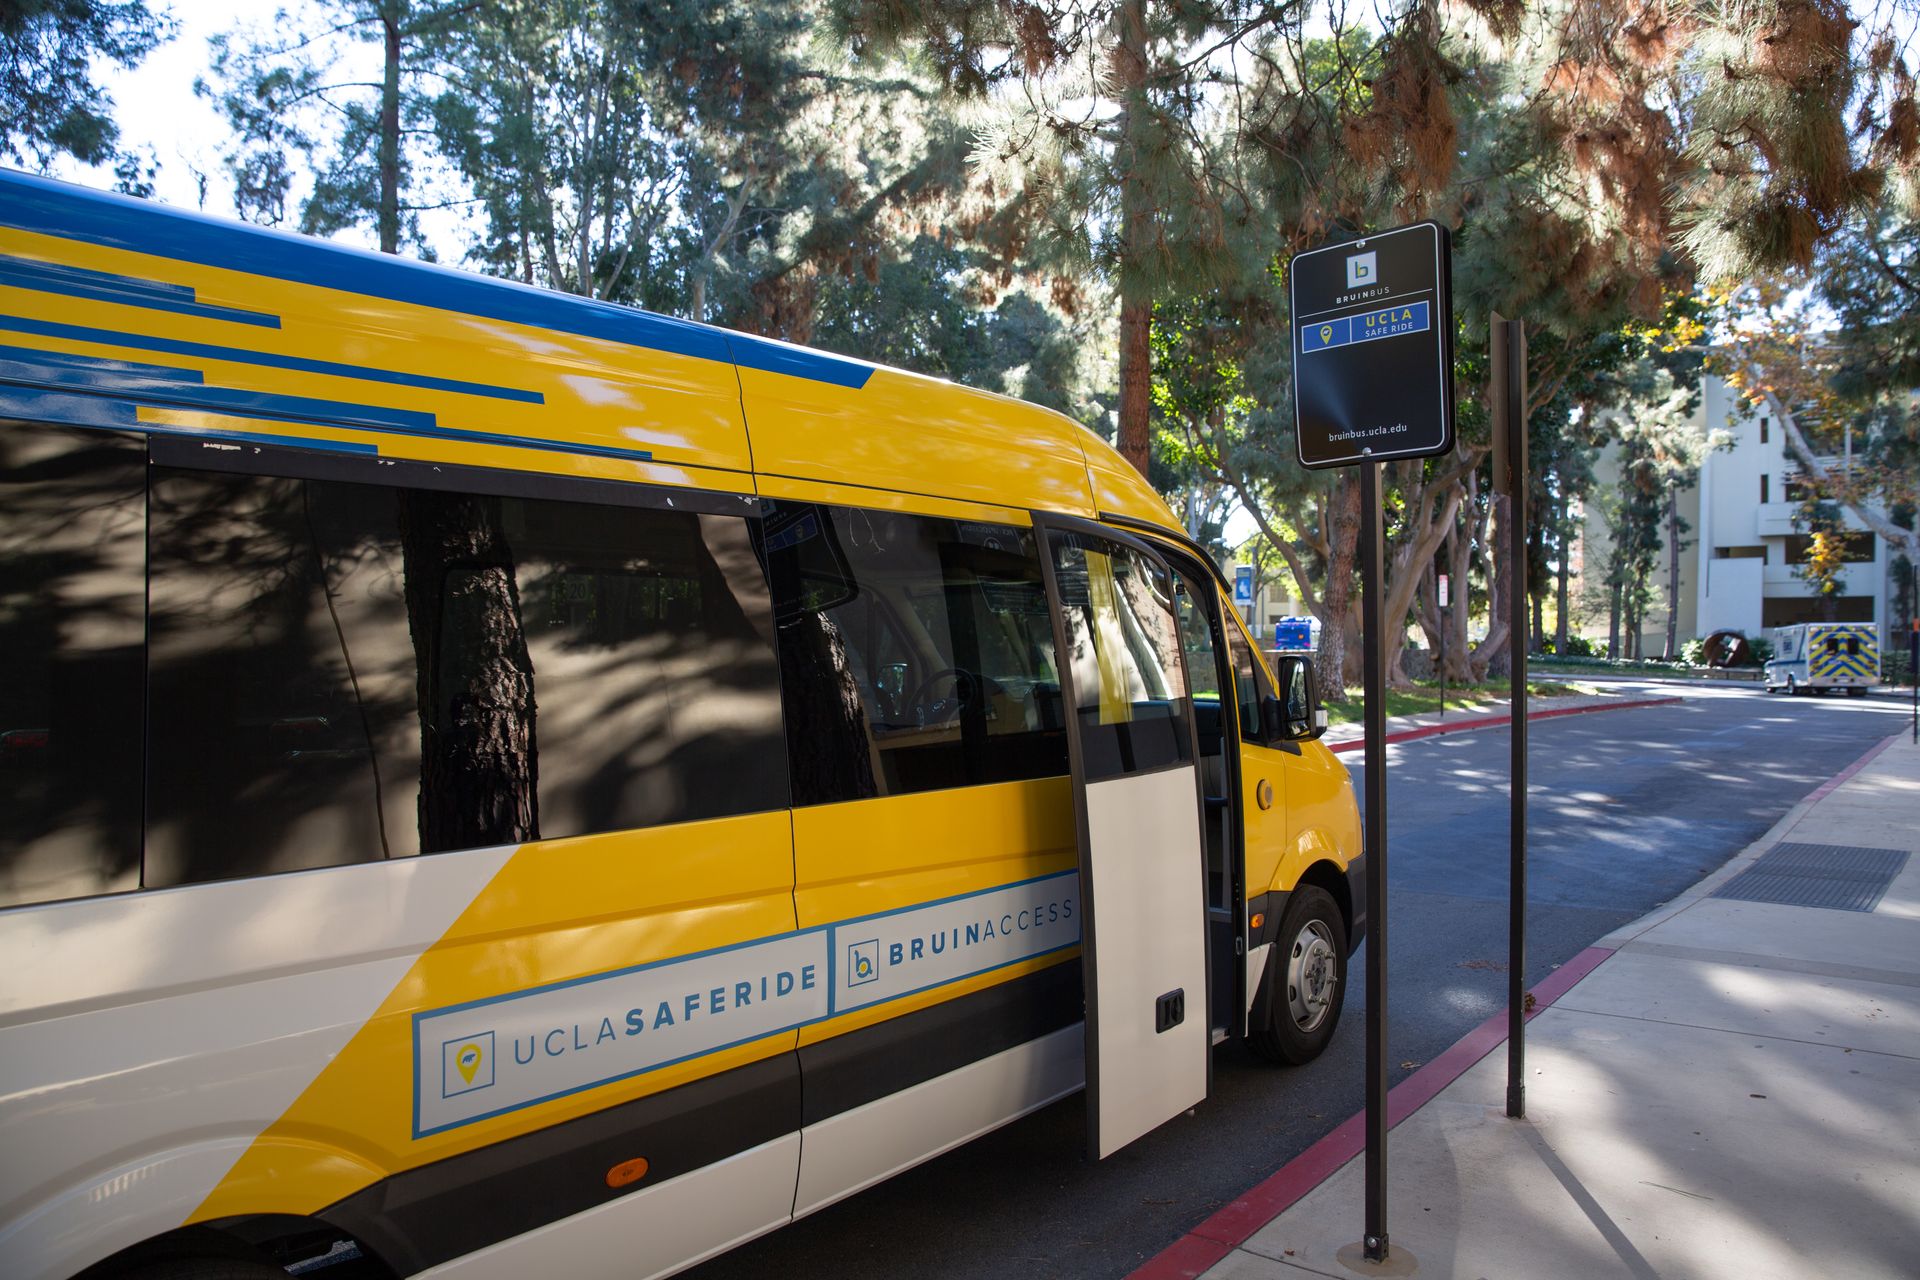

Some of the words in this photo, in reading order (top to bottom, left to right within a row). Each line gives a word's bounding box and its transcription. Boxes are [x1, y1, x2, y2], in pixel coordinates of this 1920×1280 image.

[1336, 286, 1390, 304] BRUINBUS
[1366, 308, 1412, 327] UCLA
[1365, 326, 1388, 338] SAFE
[1391, 321, 1413, 333] RIDE
[1328, 423, 1407, 442] bruinbus.ucla.edu
[889, 899, 1072, 966] BRUINACCESS
